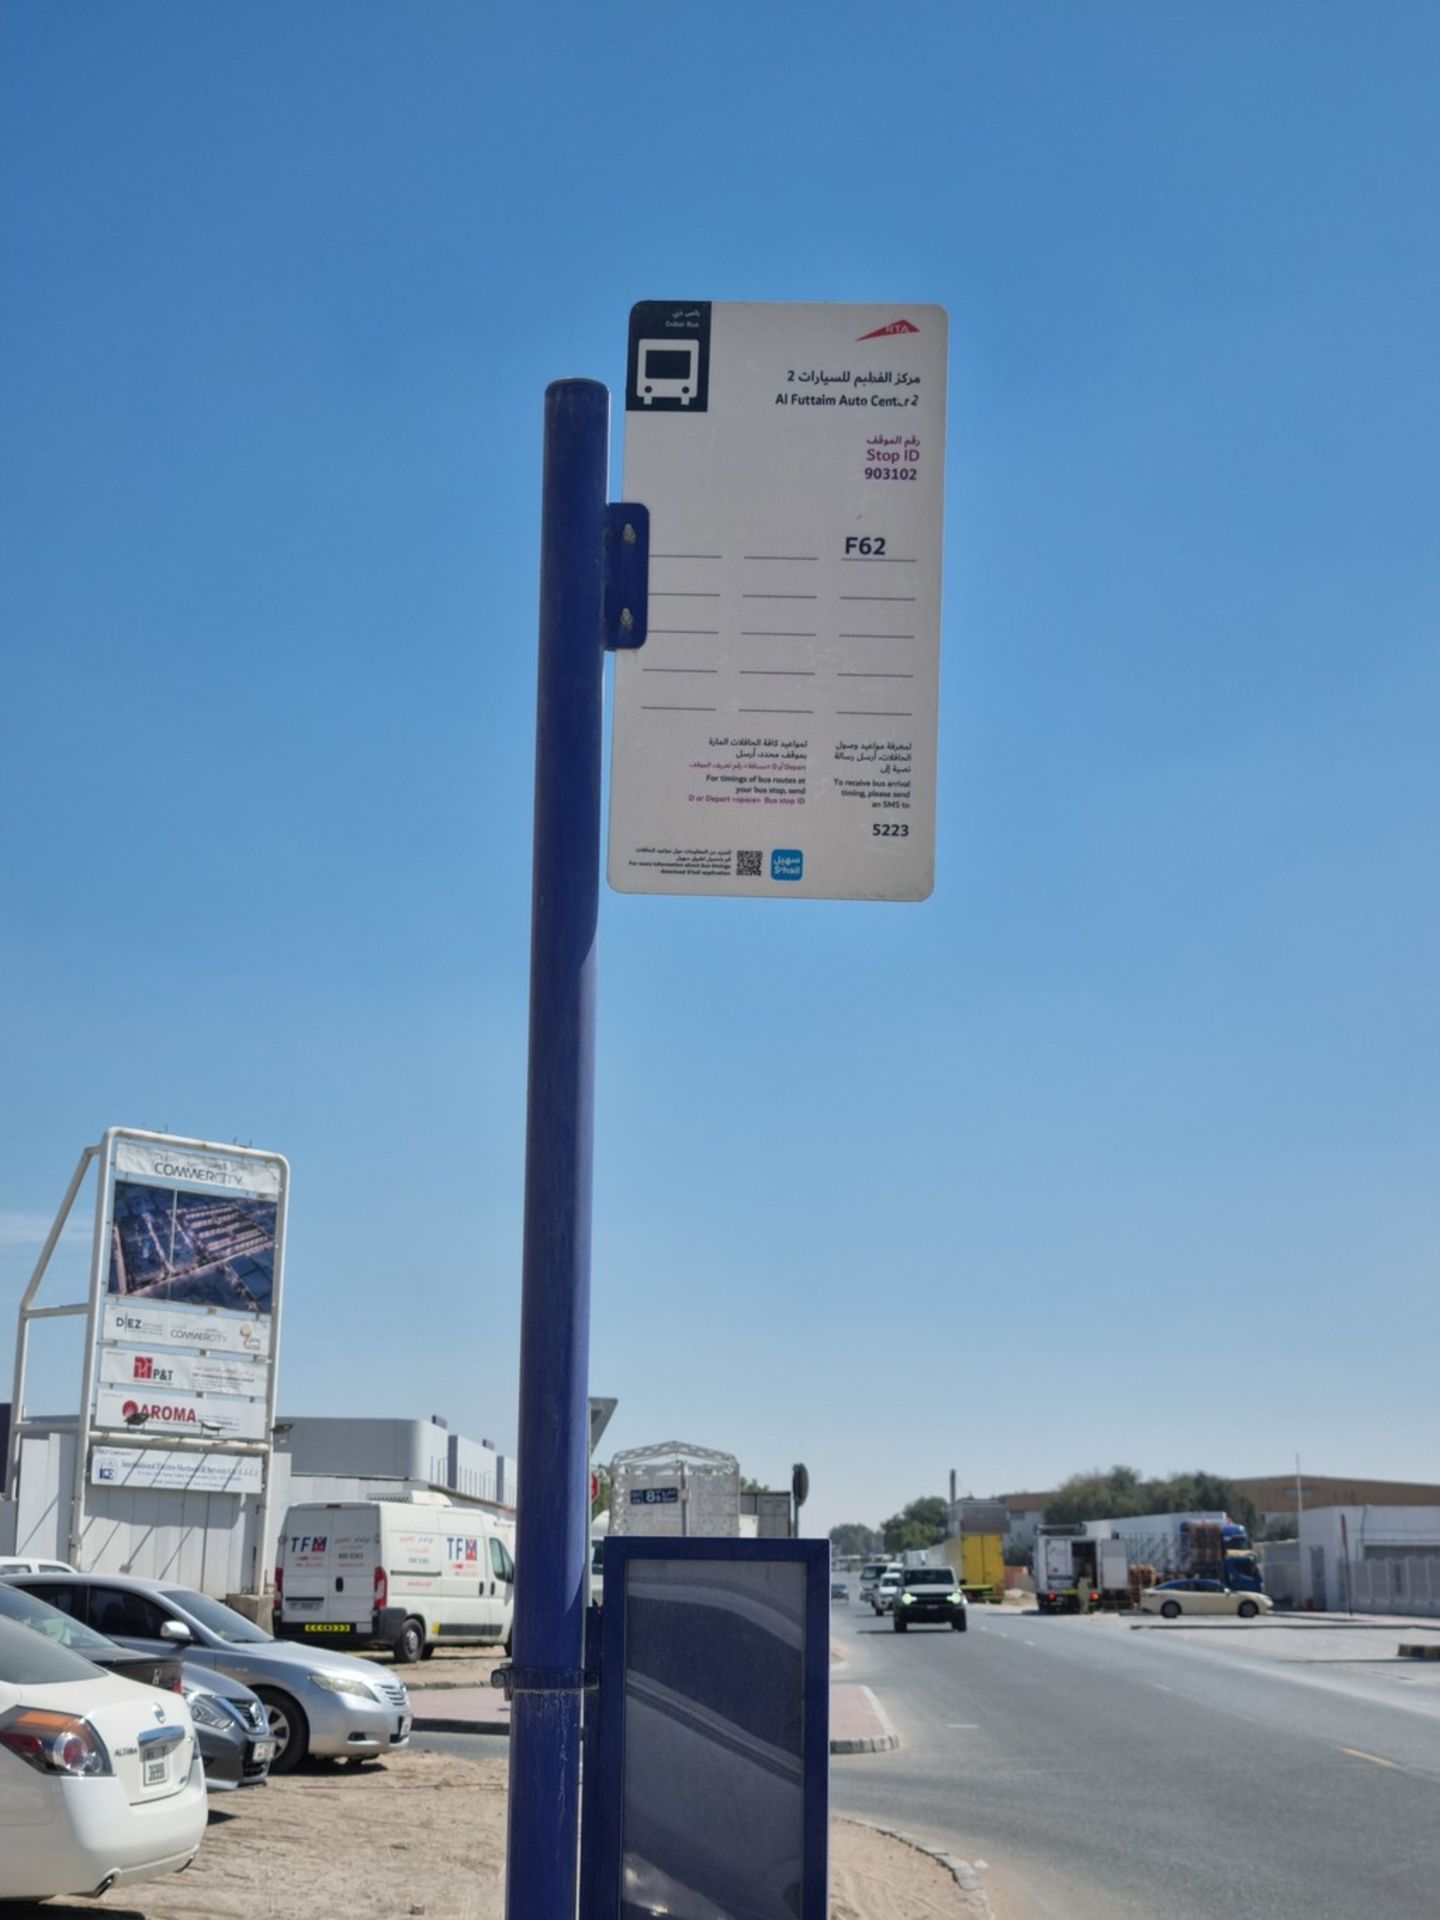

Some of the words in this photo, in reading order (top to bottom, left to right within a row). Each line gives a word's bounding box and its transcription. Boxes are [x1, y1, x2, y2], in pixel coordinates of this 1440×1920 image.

[787, 370, 795, 382] 2
[798, 370, 851, 386] للسيارات
[894, 371, 921, 386] مركز
[775, 393, 788, 405] Al
[791, 394, 836, 406] Futtaim
[839, 394, 868, 406] Auto
[911, 395, 919, 407] 2
[866, 434, 902, 447] الموقف
[904, 435, 921, 448] رقم
[866, 448, 900, 464] Stop
[904, 449, 920, 462] ID
[864, 467, 917, 480] 903102
[845, 536, 886, 555] F62
[872, 823, 909, 837] 5223
[152, 1367, 174, 1381] P&T
[140, 1404, 197, 1423] AROMA
[291, 1536, 327, 1553] TFM
[446, 1537, 477, 1561] TFM
